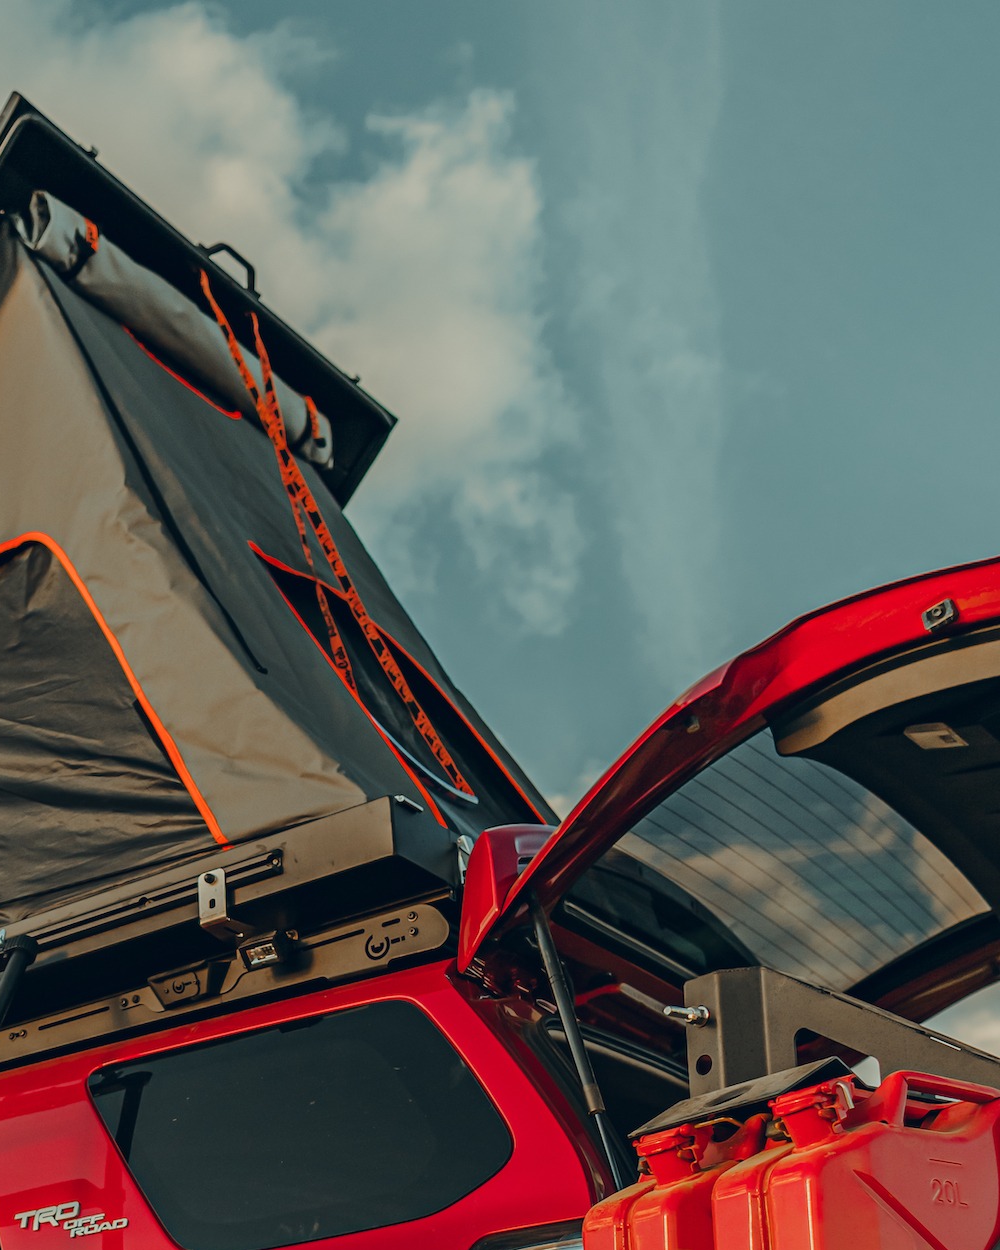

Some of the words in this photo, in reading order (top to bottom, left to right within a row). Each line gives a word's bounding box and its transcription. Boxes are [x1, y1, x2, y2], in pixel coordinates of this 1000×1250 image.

[930, 1178, 969, 1209] 20L
[63, 1213, 105, 1230] OFF
[69, 1217, 128, 1238] ROAD
